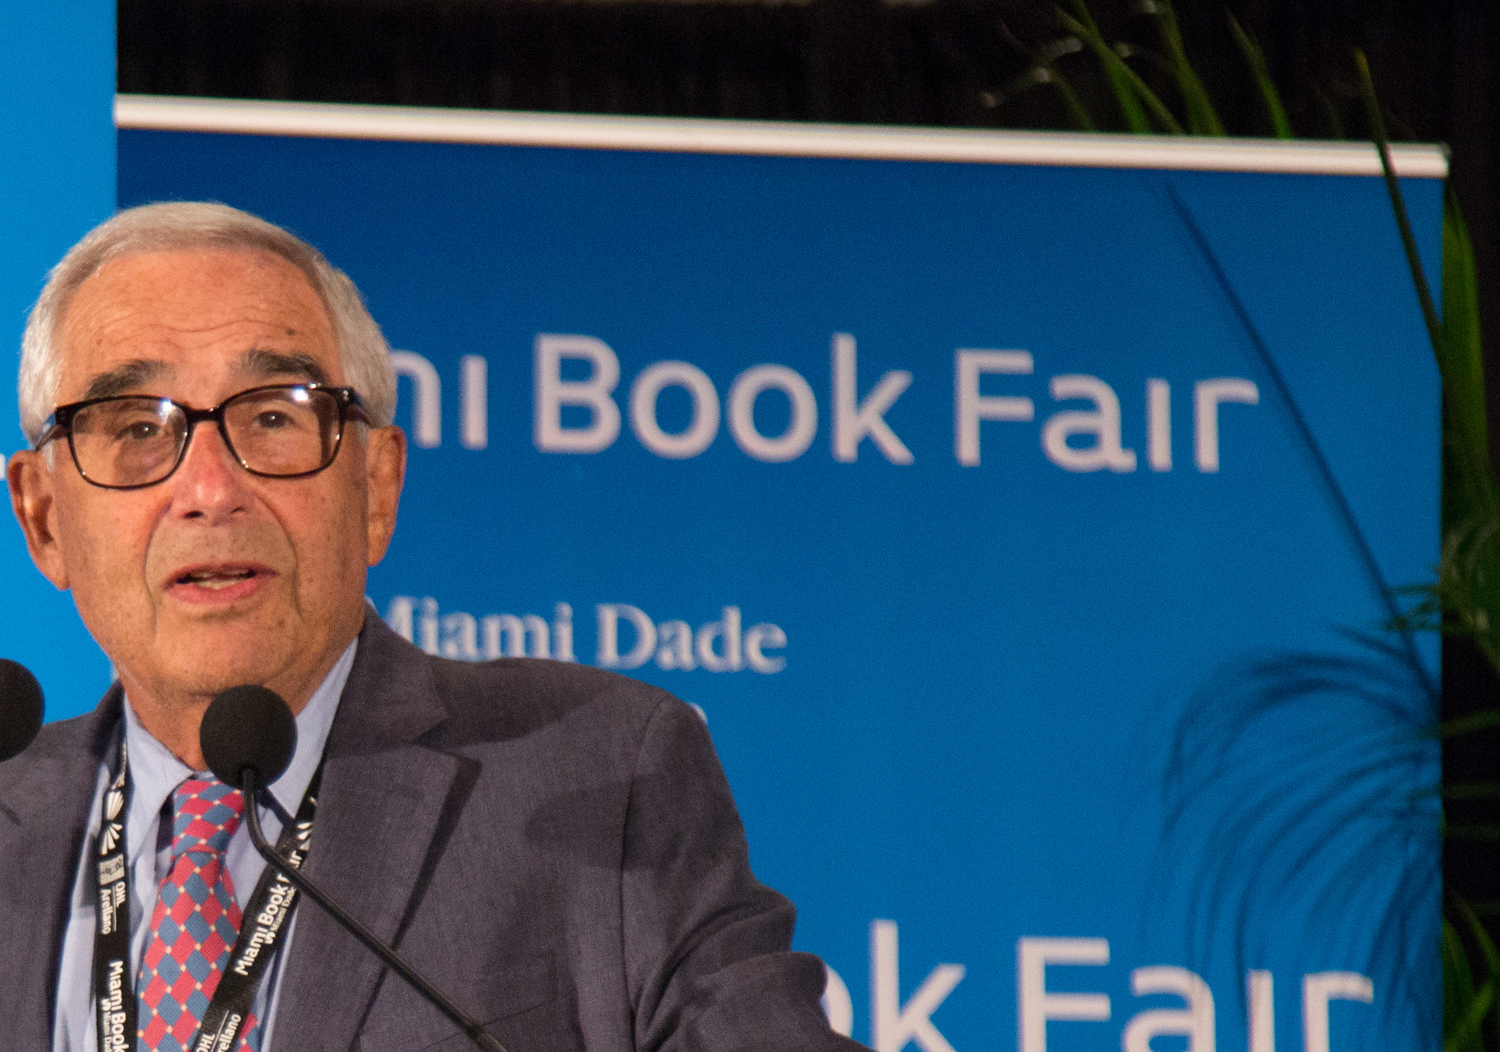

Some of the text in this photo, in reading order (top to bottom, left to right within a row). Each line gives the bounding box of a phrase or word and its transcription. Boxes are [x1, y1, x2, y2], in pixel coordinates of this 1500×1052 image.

[533, 332, 914, 466] Book
[954, 348, 1260, 474] Fair
[596, 601, 788, 674] Dade
[101, 887, 112, 935] Arellano
[116, 880, 126, 908] OHL
[234, 926, 269, 976] Miami
[257, 882, 288, 926] Book
[108, 960, 124, 1011] Miami
